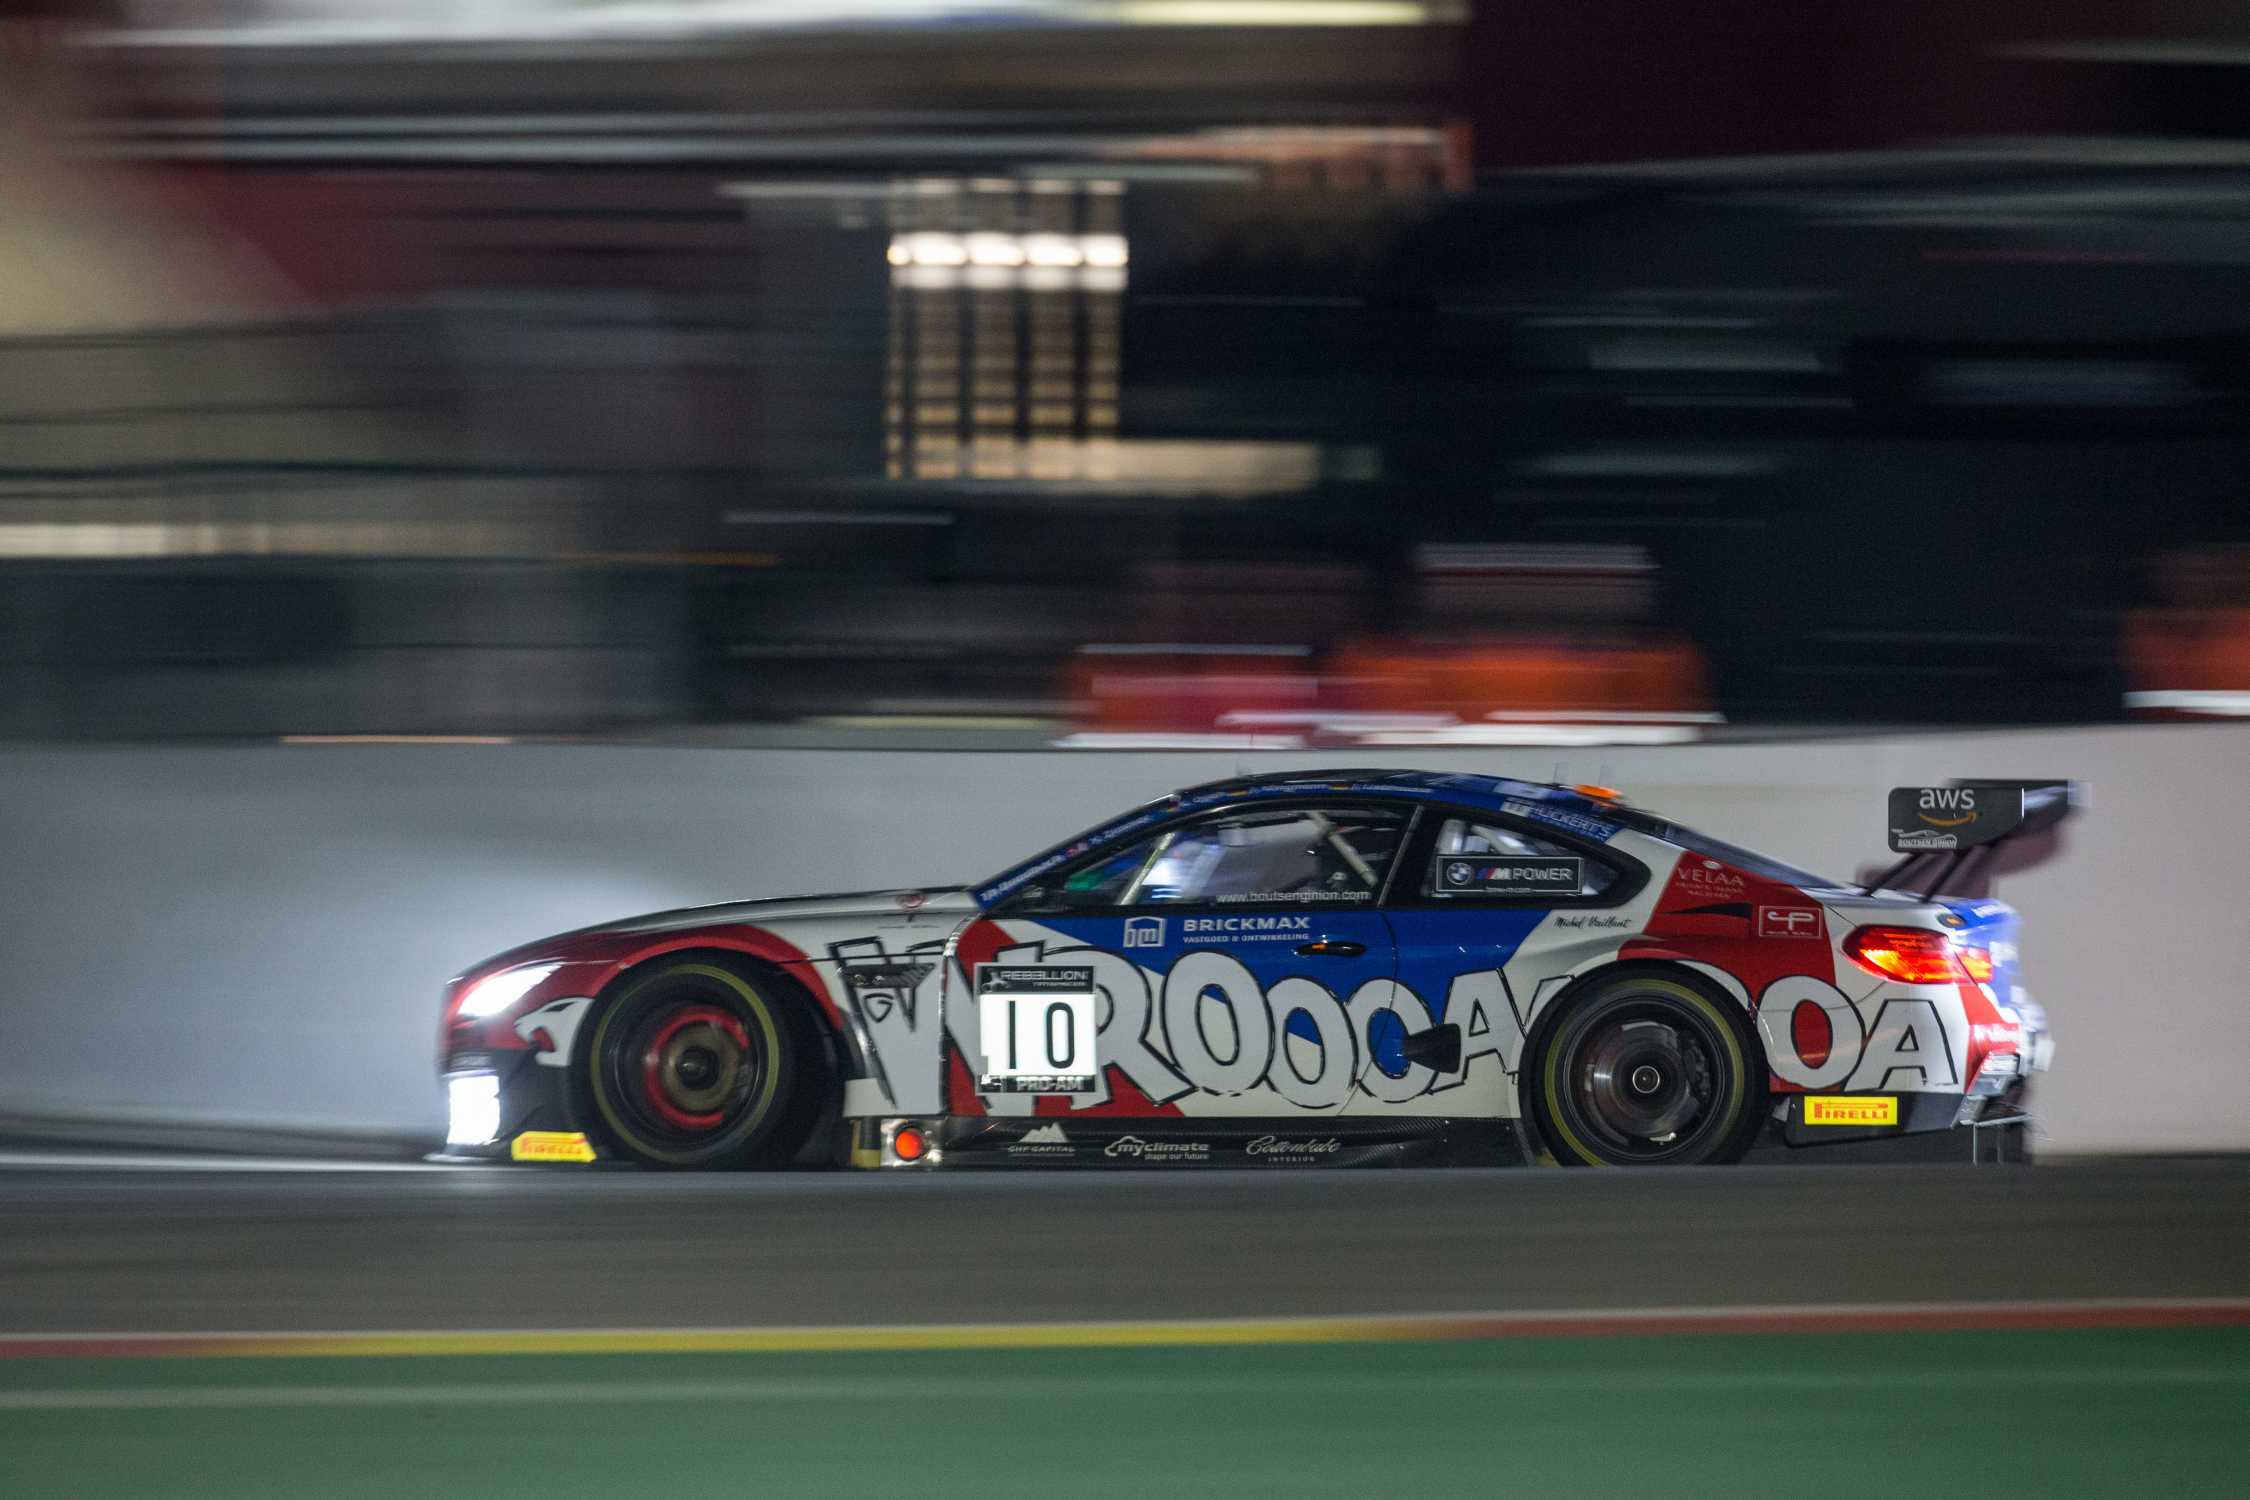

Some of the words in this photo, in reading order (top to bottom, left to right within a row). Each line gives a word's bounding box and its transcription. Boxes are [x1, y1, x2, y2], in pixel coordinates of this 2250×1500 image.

[1919, 787, 1975, 810] aws
[1512, 867, 1574, 881] POWER
[1678, 868, 1744, 886] VELAA
[1183, 916, 1312, 932] BRICKMAX
[1000, 970, 1088, 981] REBELLION
[1007, 1000, 1075, 1070] 10
[1016, 1076, 1083, 1092] PRO-AM
[1814, 1103, 1888, 1120] PIRELLI
[1117, 1142, 1209, 1157] myclimate
